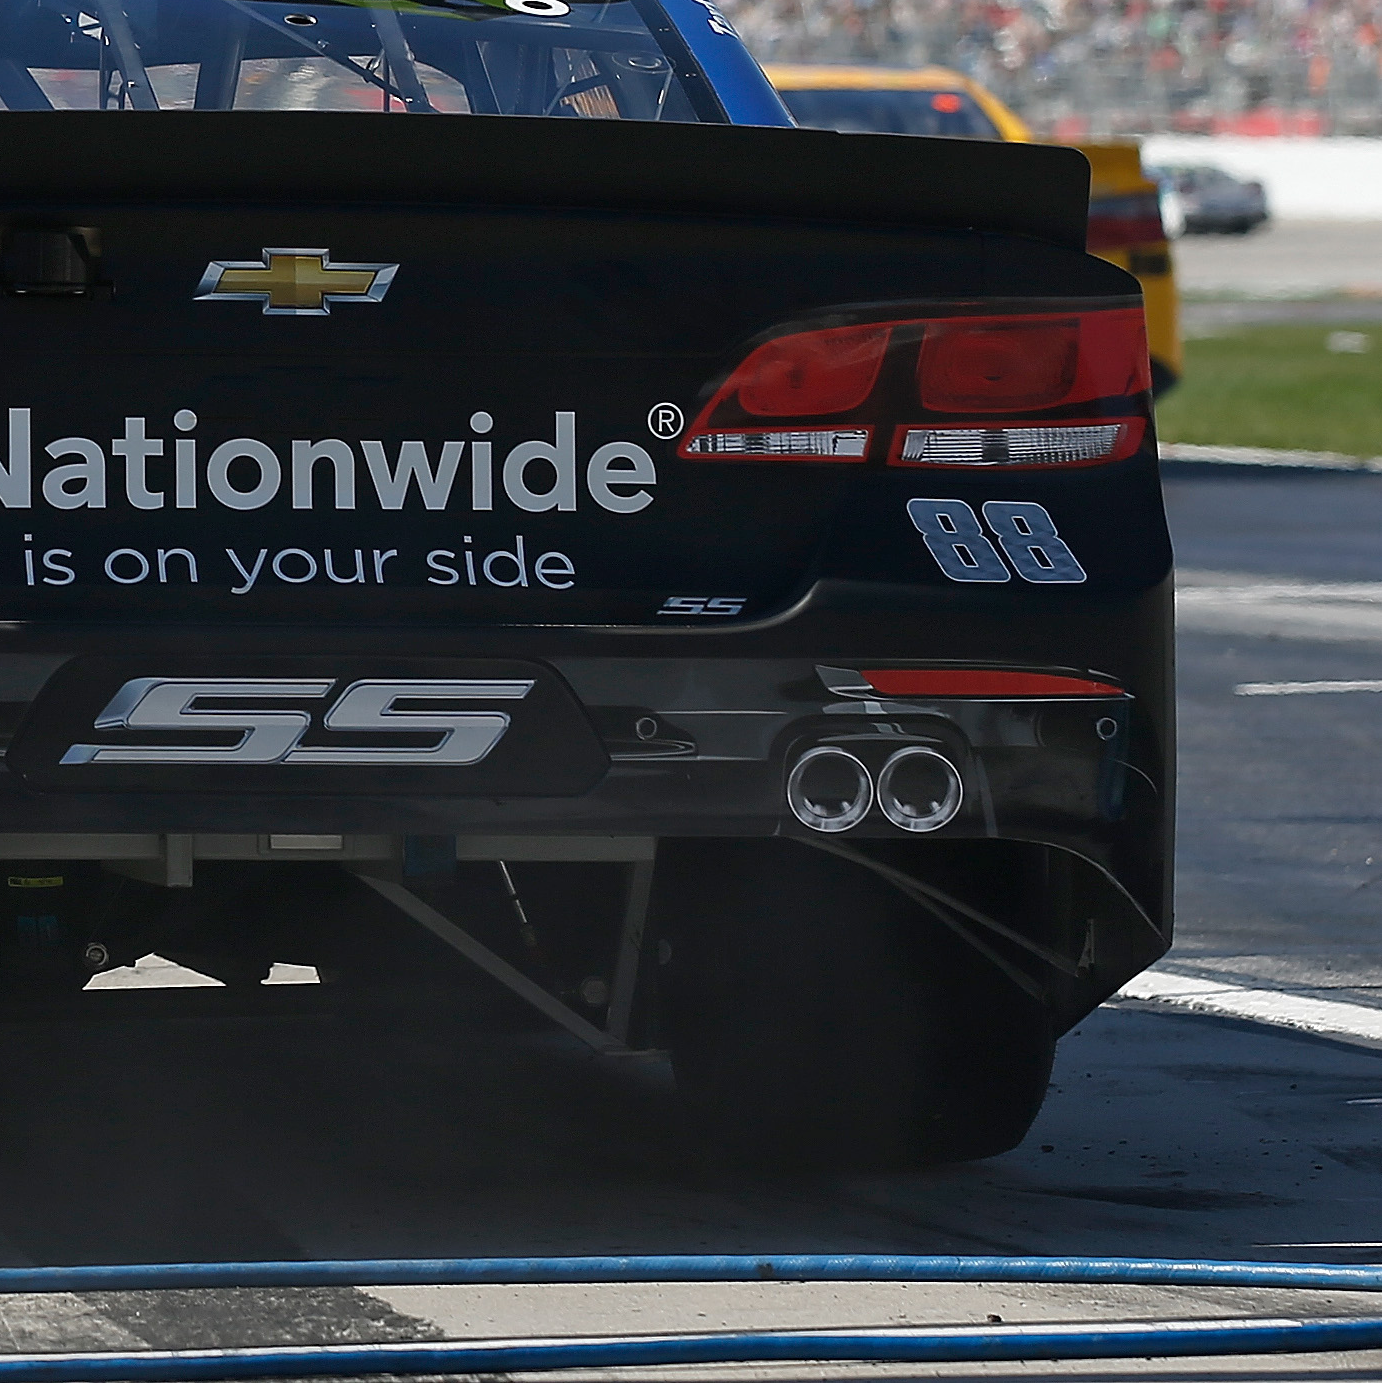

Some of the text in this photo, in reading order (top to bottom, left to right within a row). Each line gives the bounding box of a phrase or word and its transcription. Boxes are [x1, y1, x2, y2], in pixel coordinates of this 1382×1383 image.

[23, 532, 577, 595] is on your side
[906, 497, 1088, 584] 88
[656, 597, 747, 616] SS
[59, 677, 537, 766] SS
